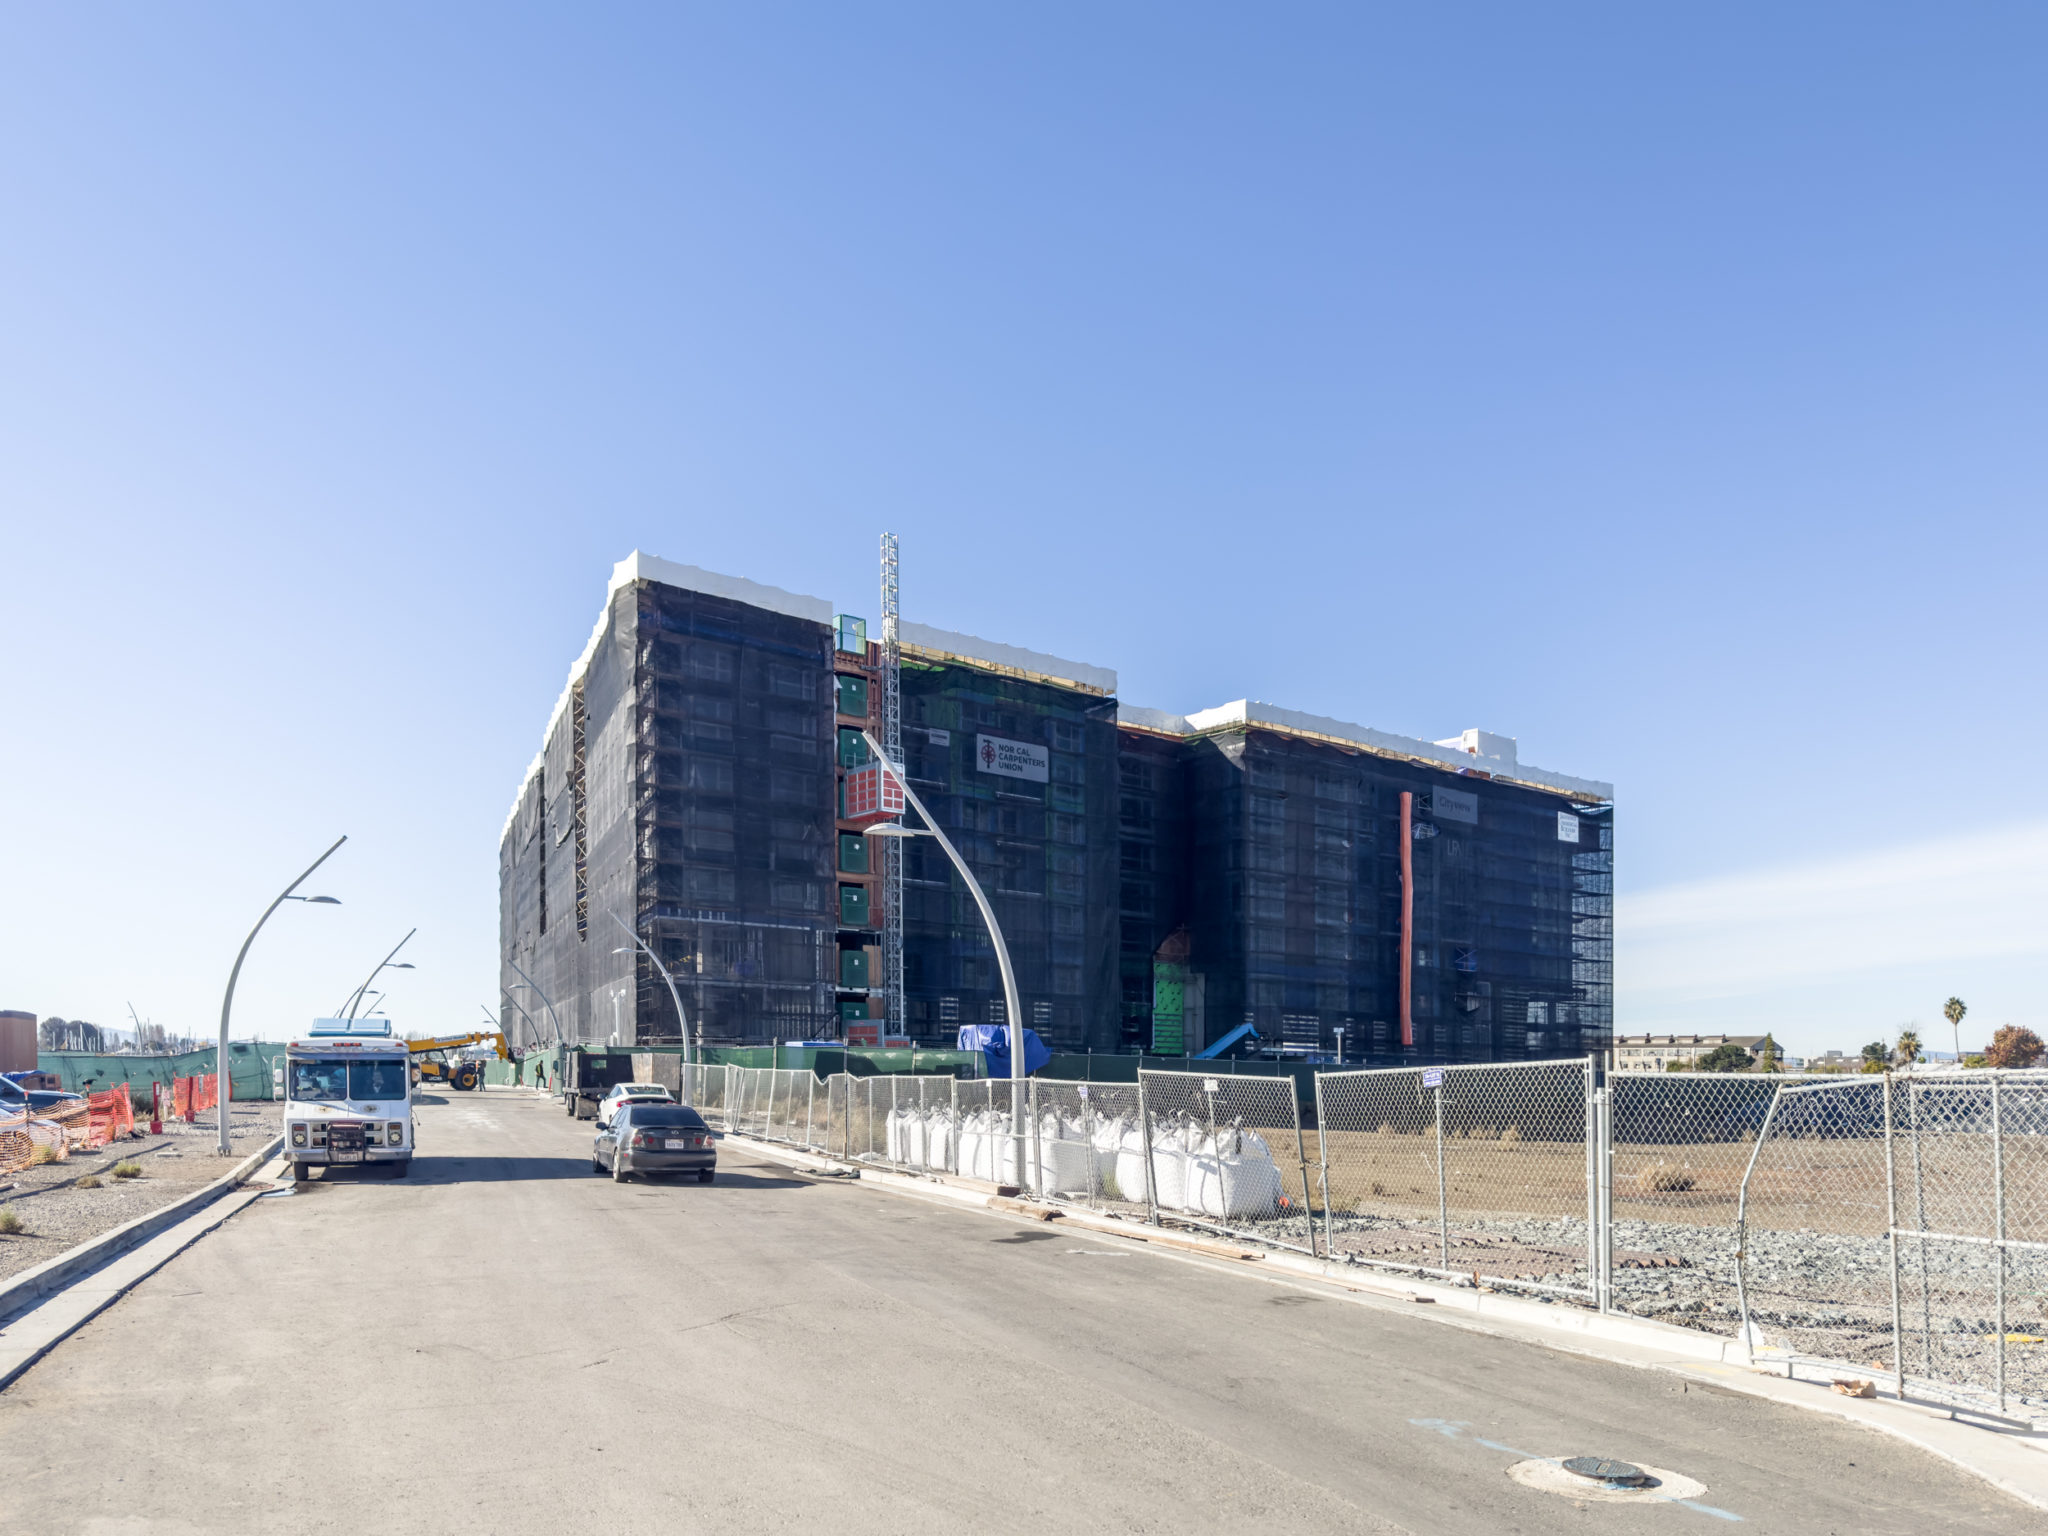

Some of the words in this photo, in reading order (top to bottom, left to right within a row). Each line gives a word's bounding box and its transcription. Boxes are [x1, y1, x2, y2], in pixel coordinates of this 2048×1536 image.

[998, 744, 1015, 754] NOR
[1016, 747, 1030, 757] CAL
[998, 752, 1046, 768] CARPENTERS
[998, 761, 1023, 772] UNION
